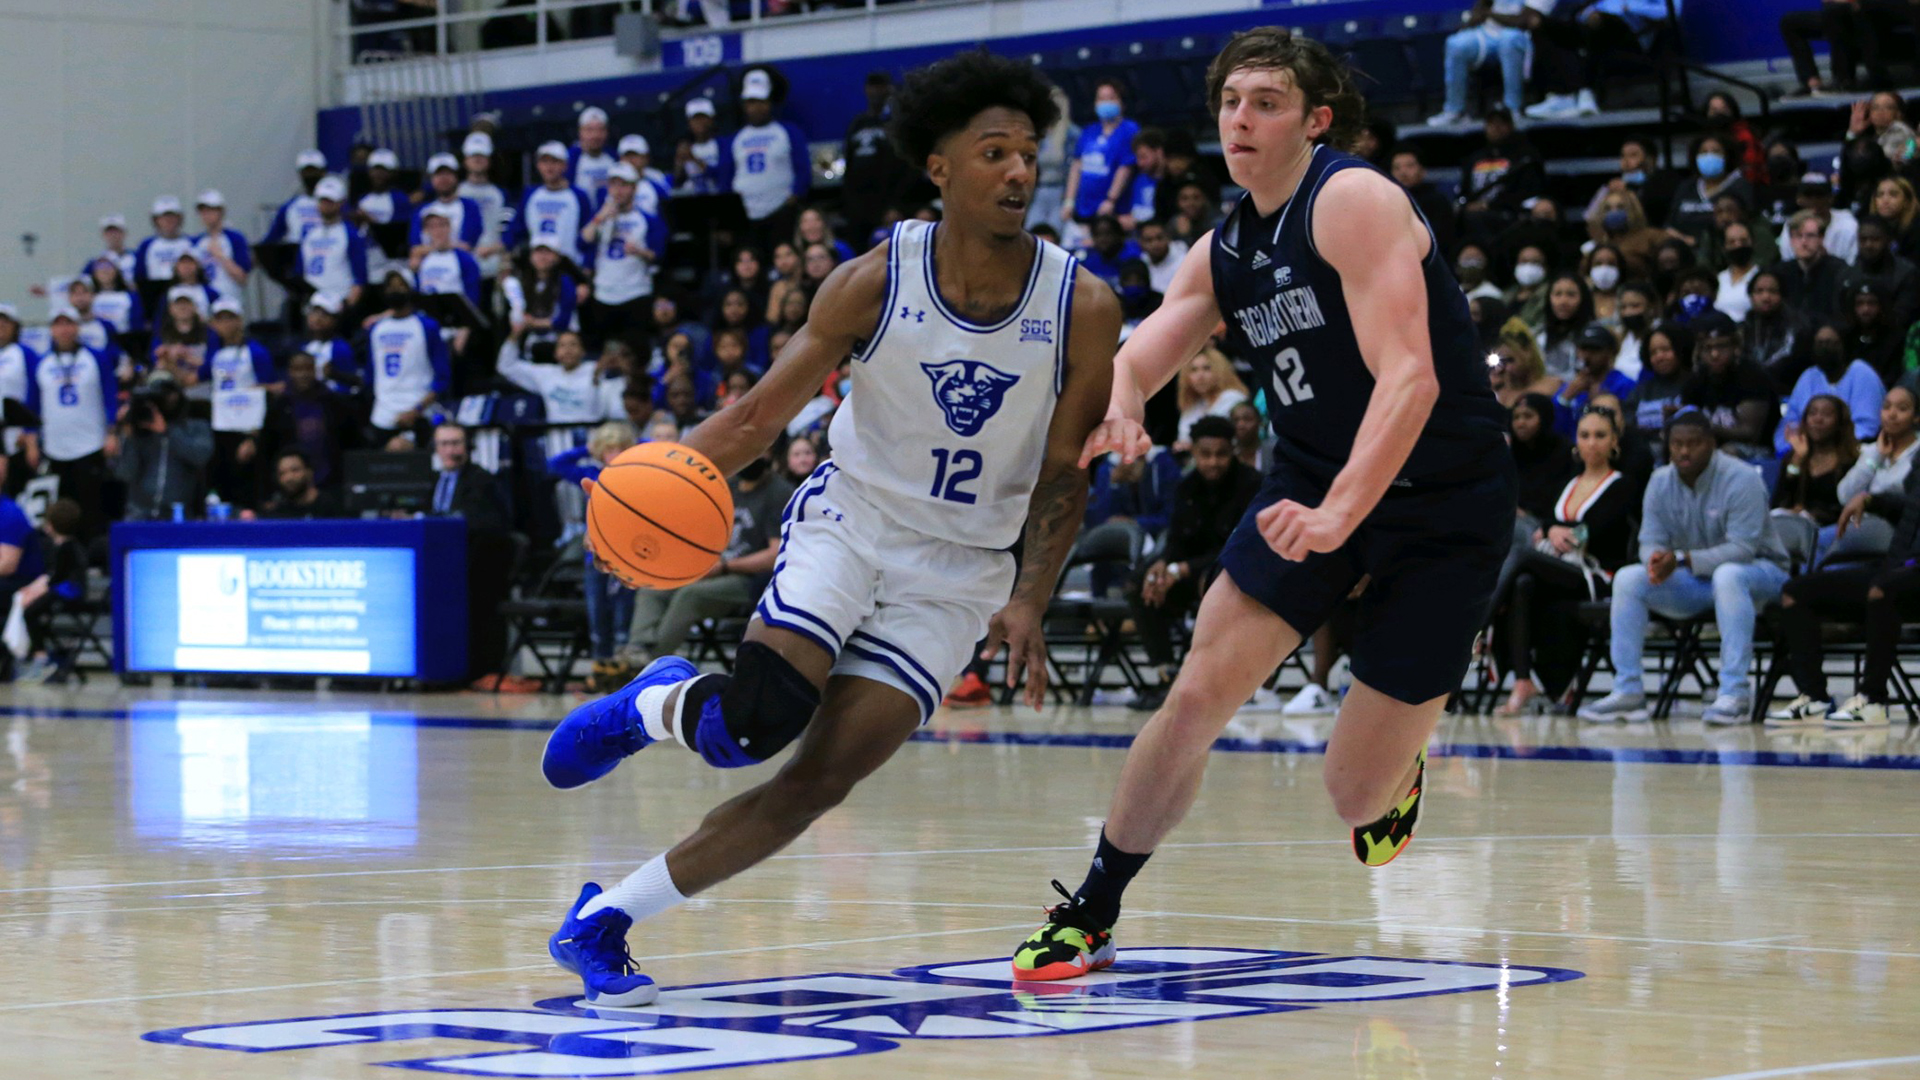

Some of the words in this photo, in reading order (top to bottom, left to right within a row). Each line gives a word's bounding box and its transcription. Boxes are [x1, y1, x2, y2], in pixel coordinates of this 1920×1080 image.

[682, 35, 723, 68] 109
[1020, 318, 1052, 335] SBC
[384, 352, 401, 378] 6
[930, 448, 983, 505] 12
[248, 559, 367, 589] BOOKSTORE
